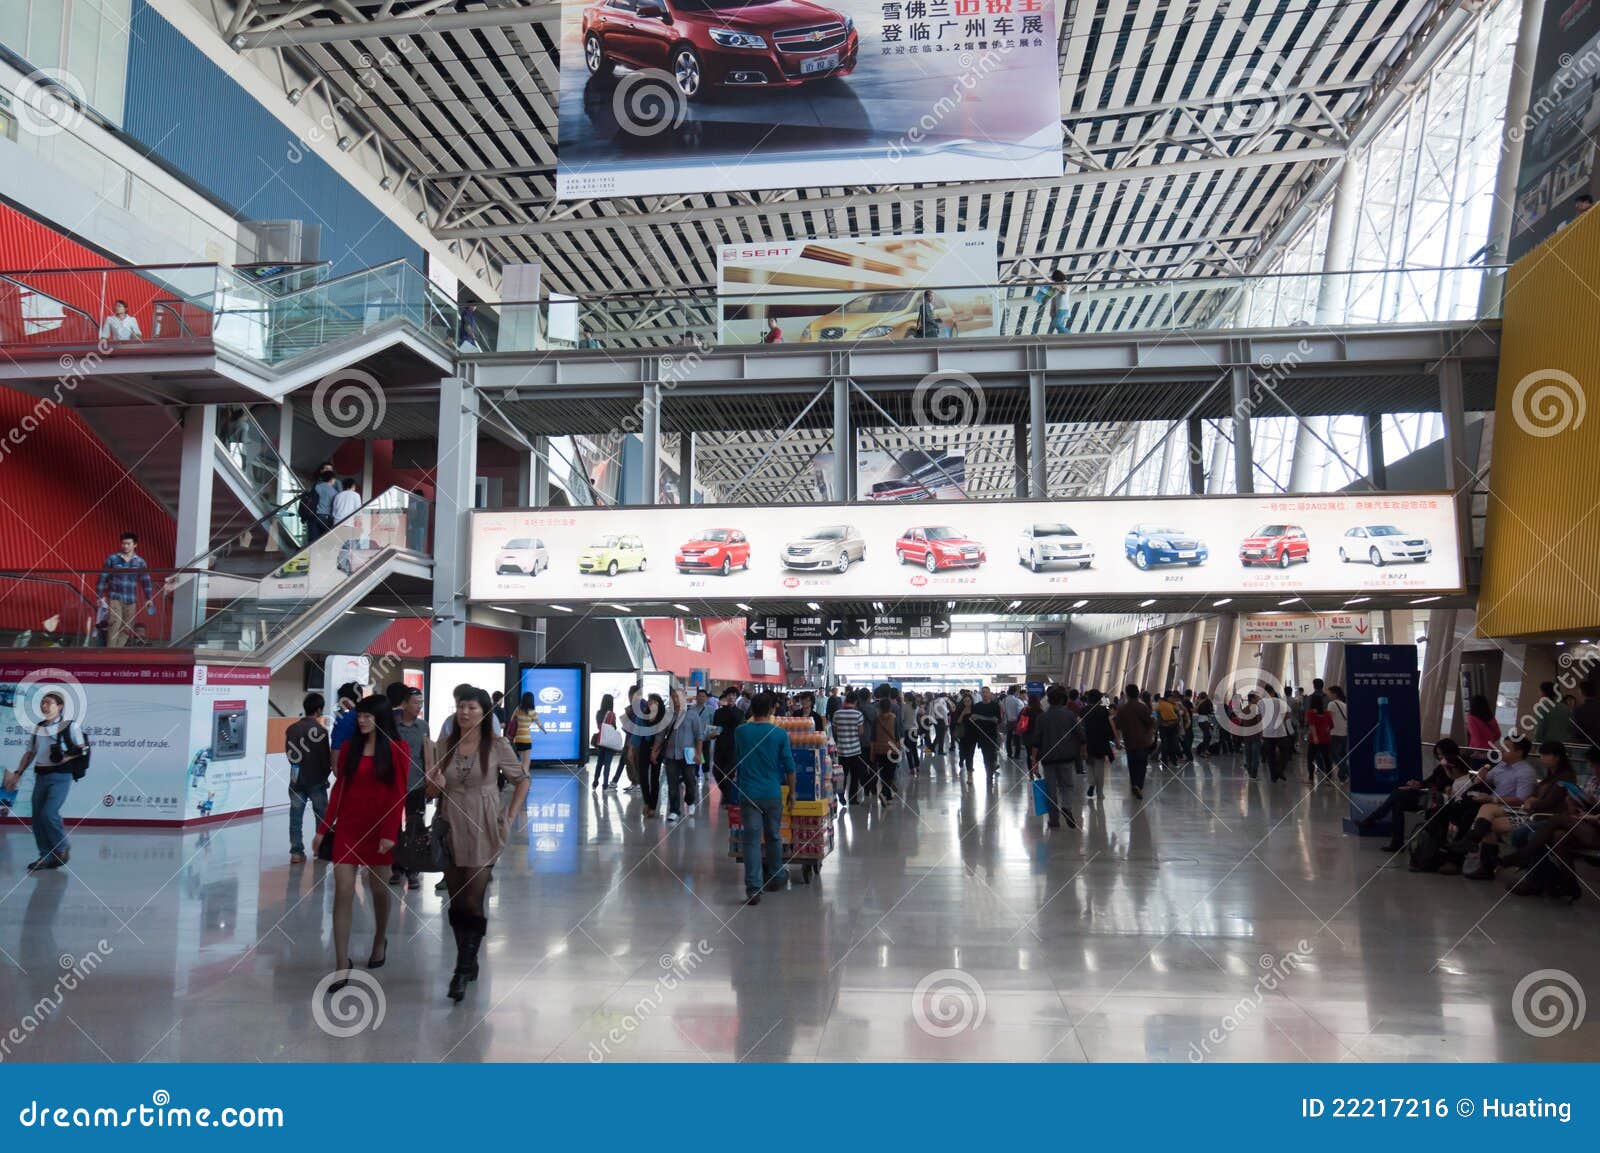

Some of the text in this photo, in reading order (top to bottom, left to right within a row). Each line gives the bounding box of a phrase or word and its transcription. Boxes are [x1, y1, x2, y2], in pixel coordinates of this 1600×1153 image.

[881, 15, 1043, 42] 登临广州车展
[881, 38, 1043, 56] 欢迎莅临3.2馆雪佛兰展台
[741, 248, 791, 258] SEAT
[4, 739, 22, 747] Bank
[99, 738, 114, 748] the
[114, 738, 136, 748] world
[137, 738, 146, 748] of
[146, 739, 171, 749] trade.
